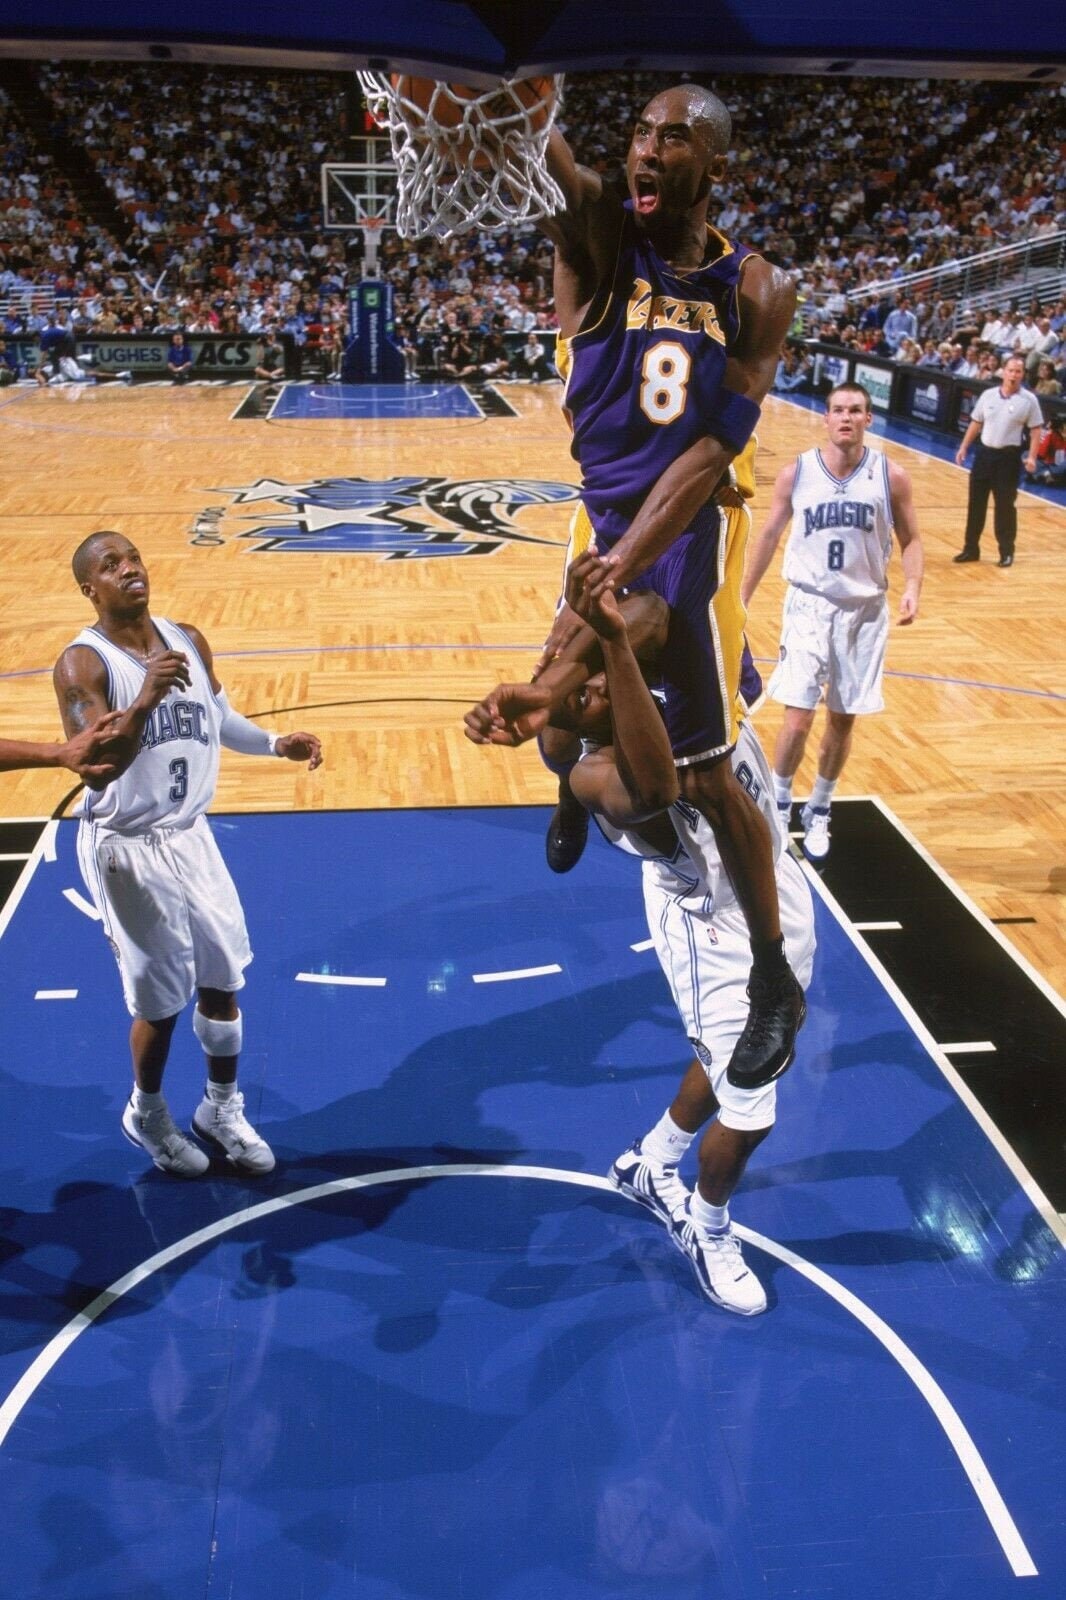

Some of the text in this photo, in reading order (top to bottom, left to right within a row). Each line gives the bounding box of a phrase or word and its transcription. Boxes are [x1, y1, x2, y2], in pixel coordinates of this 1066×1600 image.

[196, 342, 252, 366] ACS
[640, 340, 692, 426] 8
[803, 500, 875, 538] MAGIC
[828, 539, 845, 572] 8
[169, 757, 188, 802] 3
